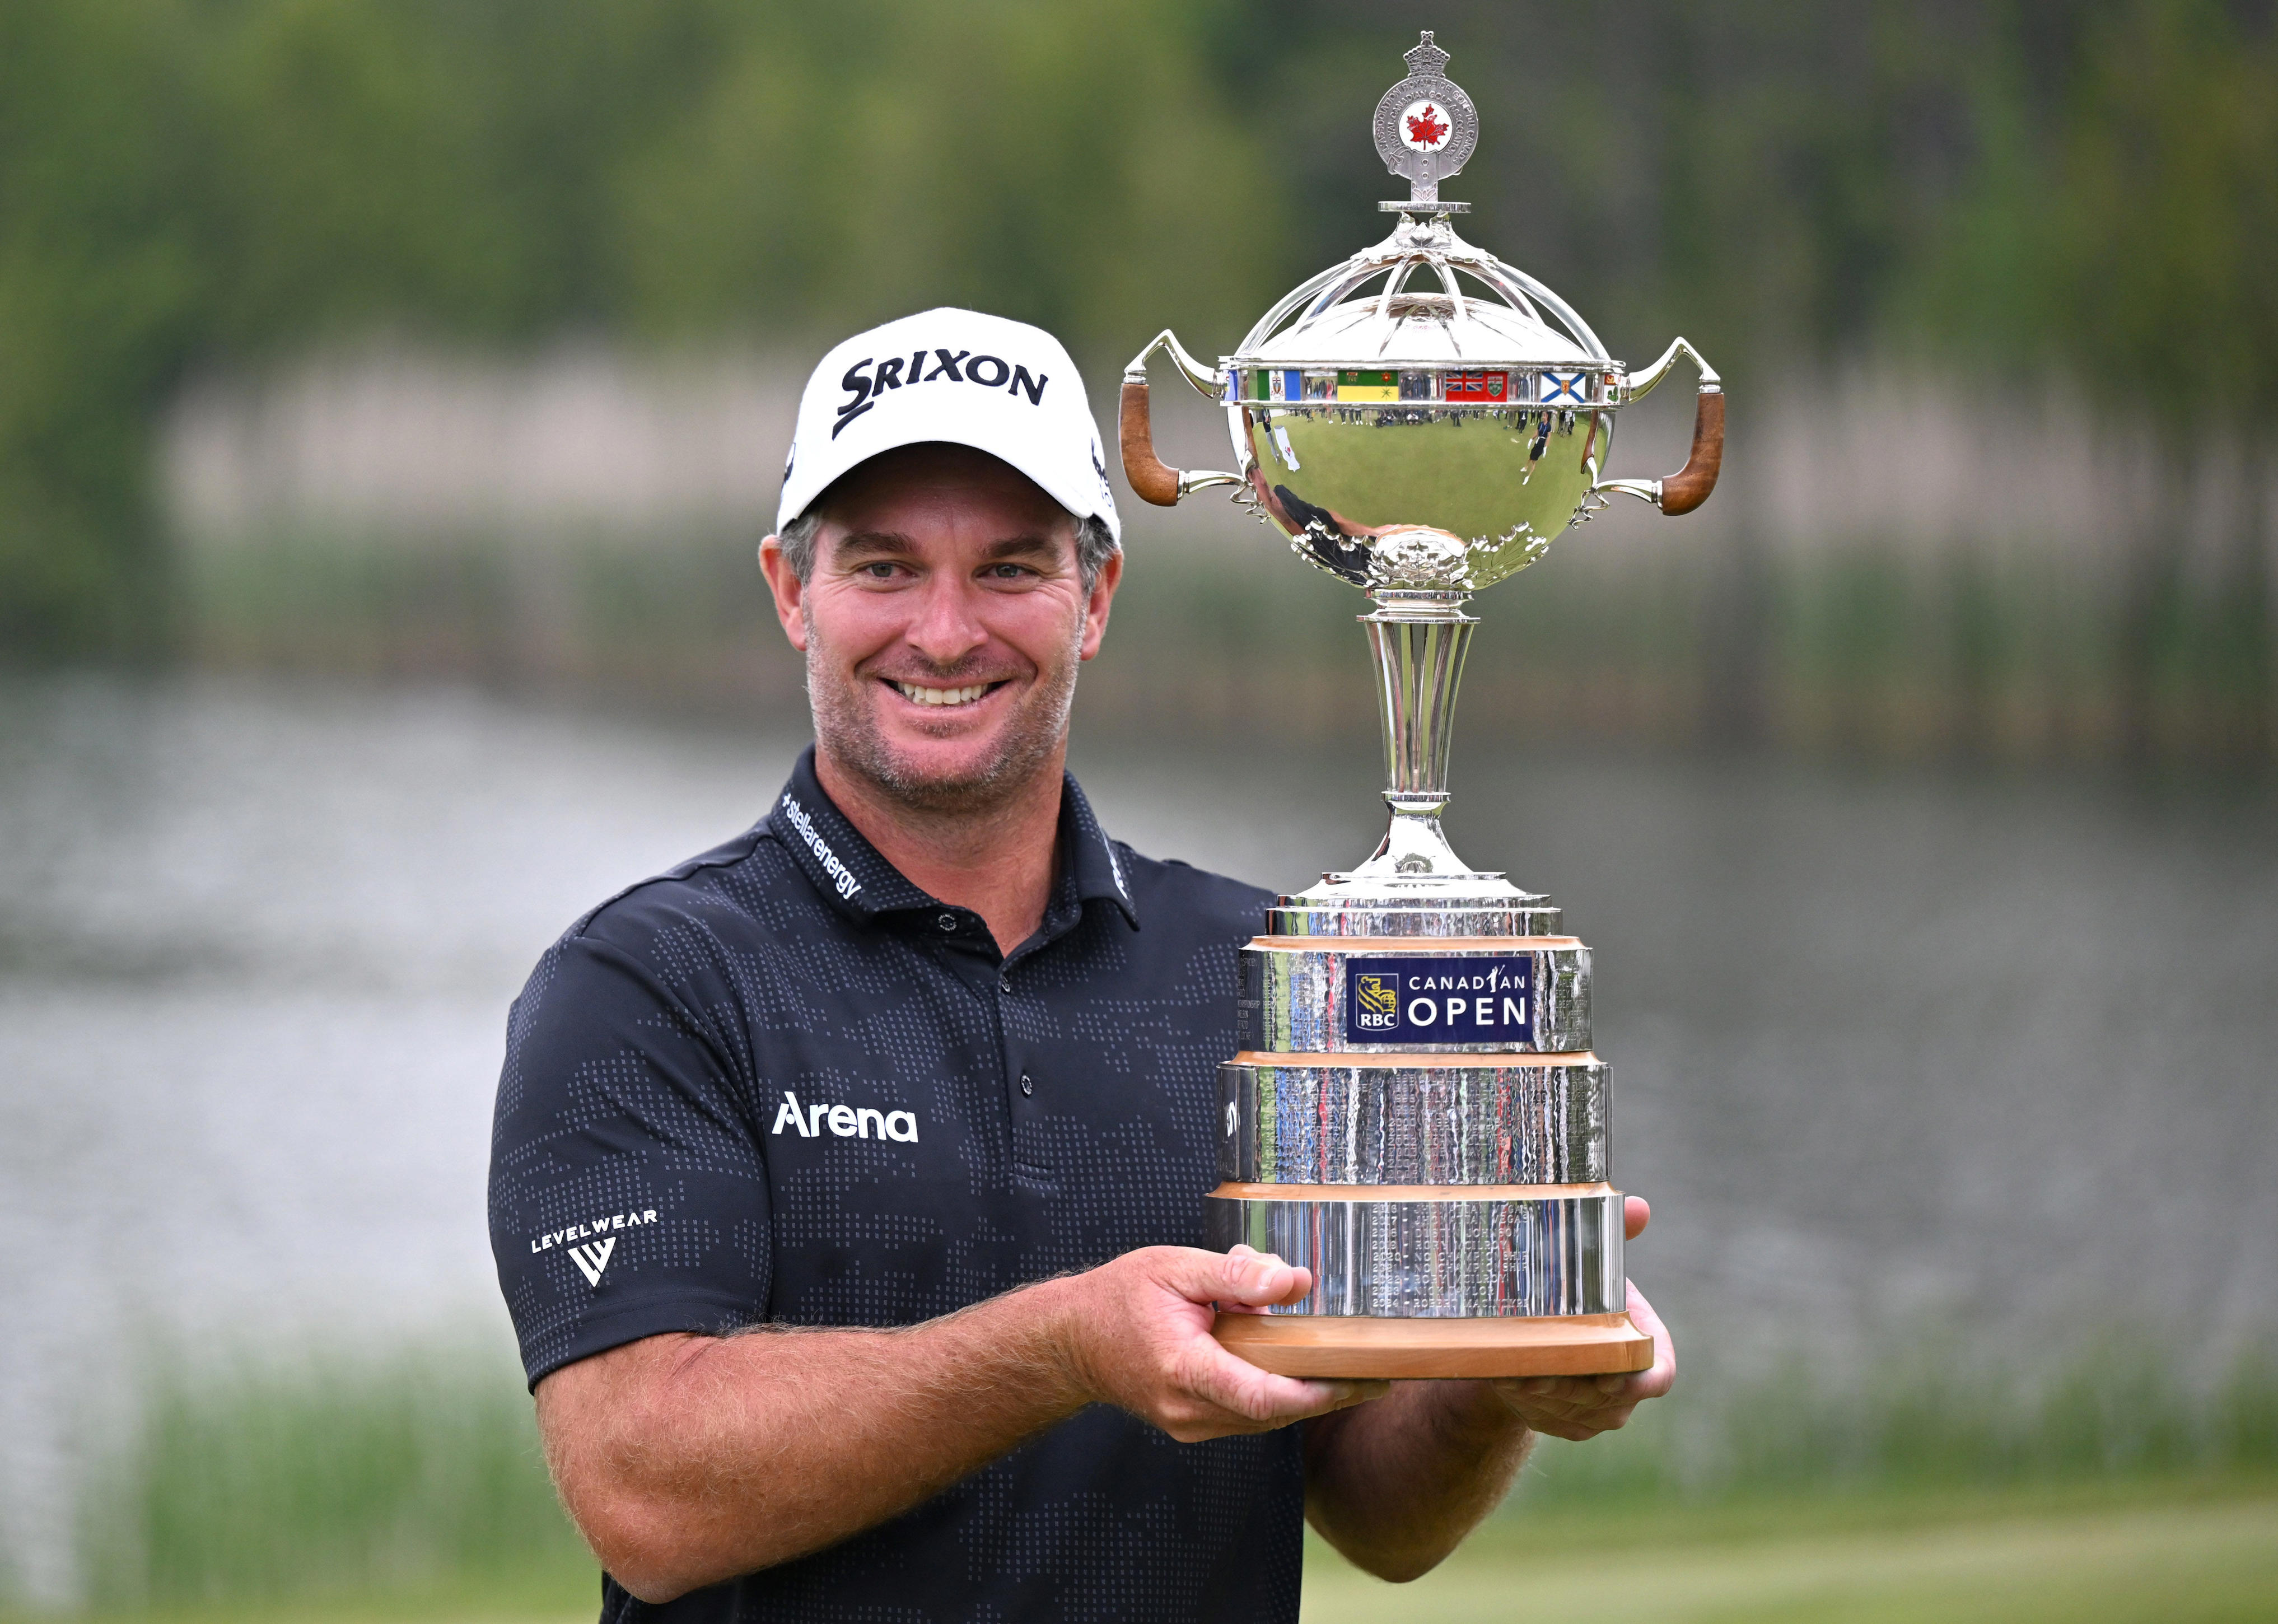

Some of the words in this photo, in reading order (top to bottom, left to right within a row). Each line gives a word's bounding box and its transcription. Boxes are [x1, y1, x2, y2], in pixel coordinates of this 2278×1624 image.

[1402, 79, 1437, 91] ROYALE
[1429, 91, 1452, 105] GOLF
[1439, 82, 1453, 93] DE
[1390, 90, 1427, 119] CANADIAN
[1452, 90, 1472, 113] GOLF
[1388, 120, 1400, 148] ROYAL
[1445, 104, 1464, 158] ASSOCIATION
[1465, 114, 1476, 126] DU
[1453, 130, 1475, 165] CANADA
[832, 349, 1048, 440] SRIXON
[1409, 969, 1525, 992] CANADIAN
[1361, 1013, 1395, 1026] RBC
[1408, 997, 1526, 1026] OPEN
[771, 1090, 919, 1143] Arena
[531, 1210, 658, 1254] LEVELWEAR
